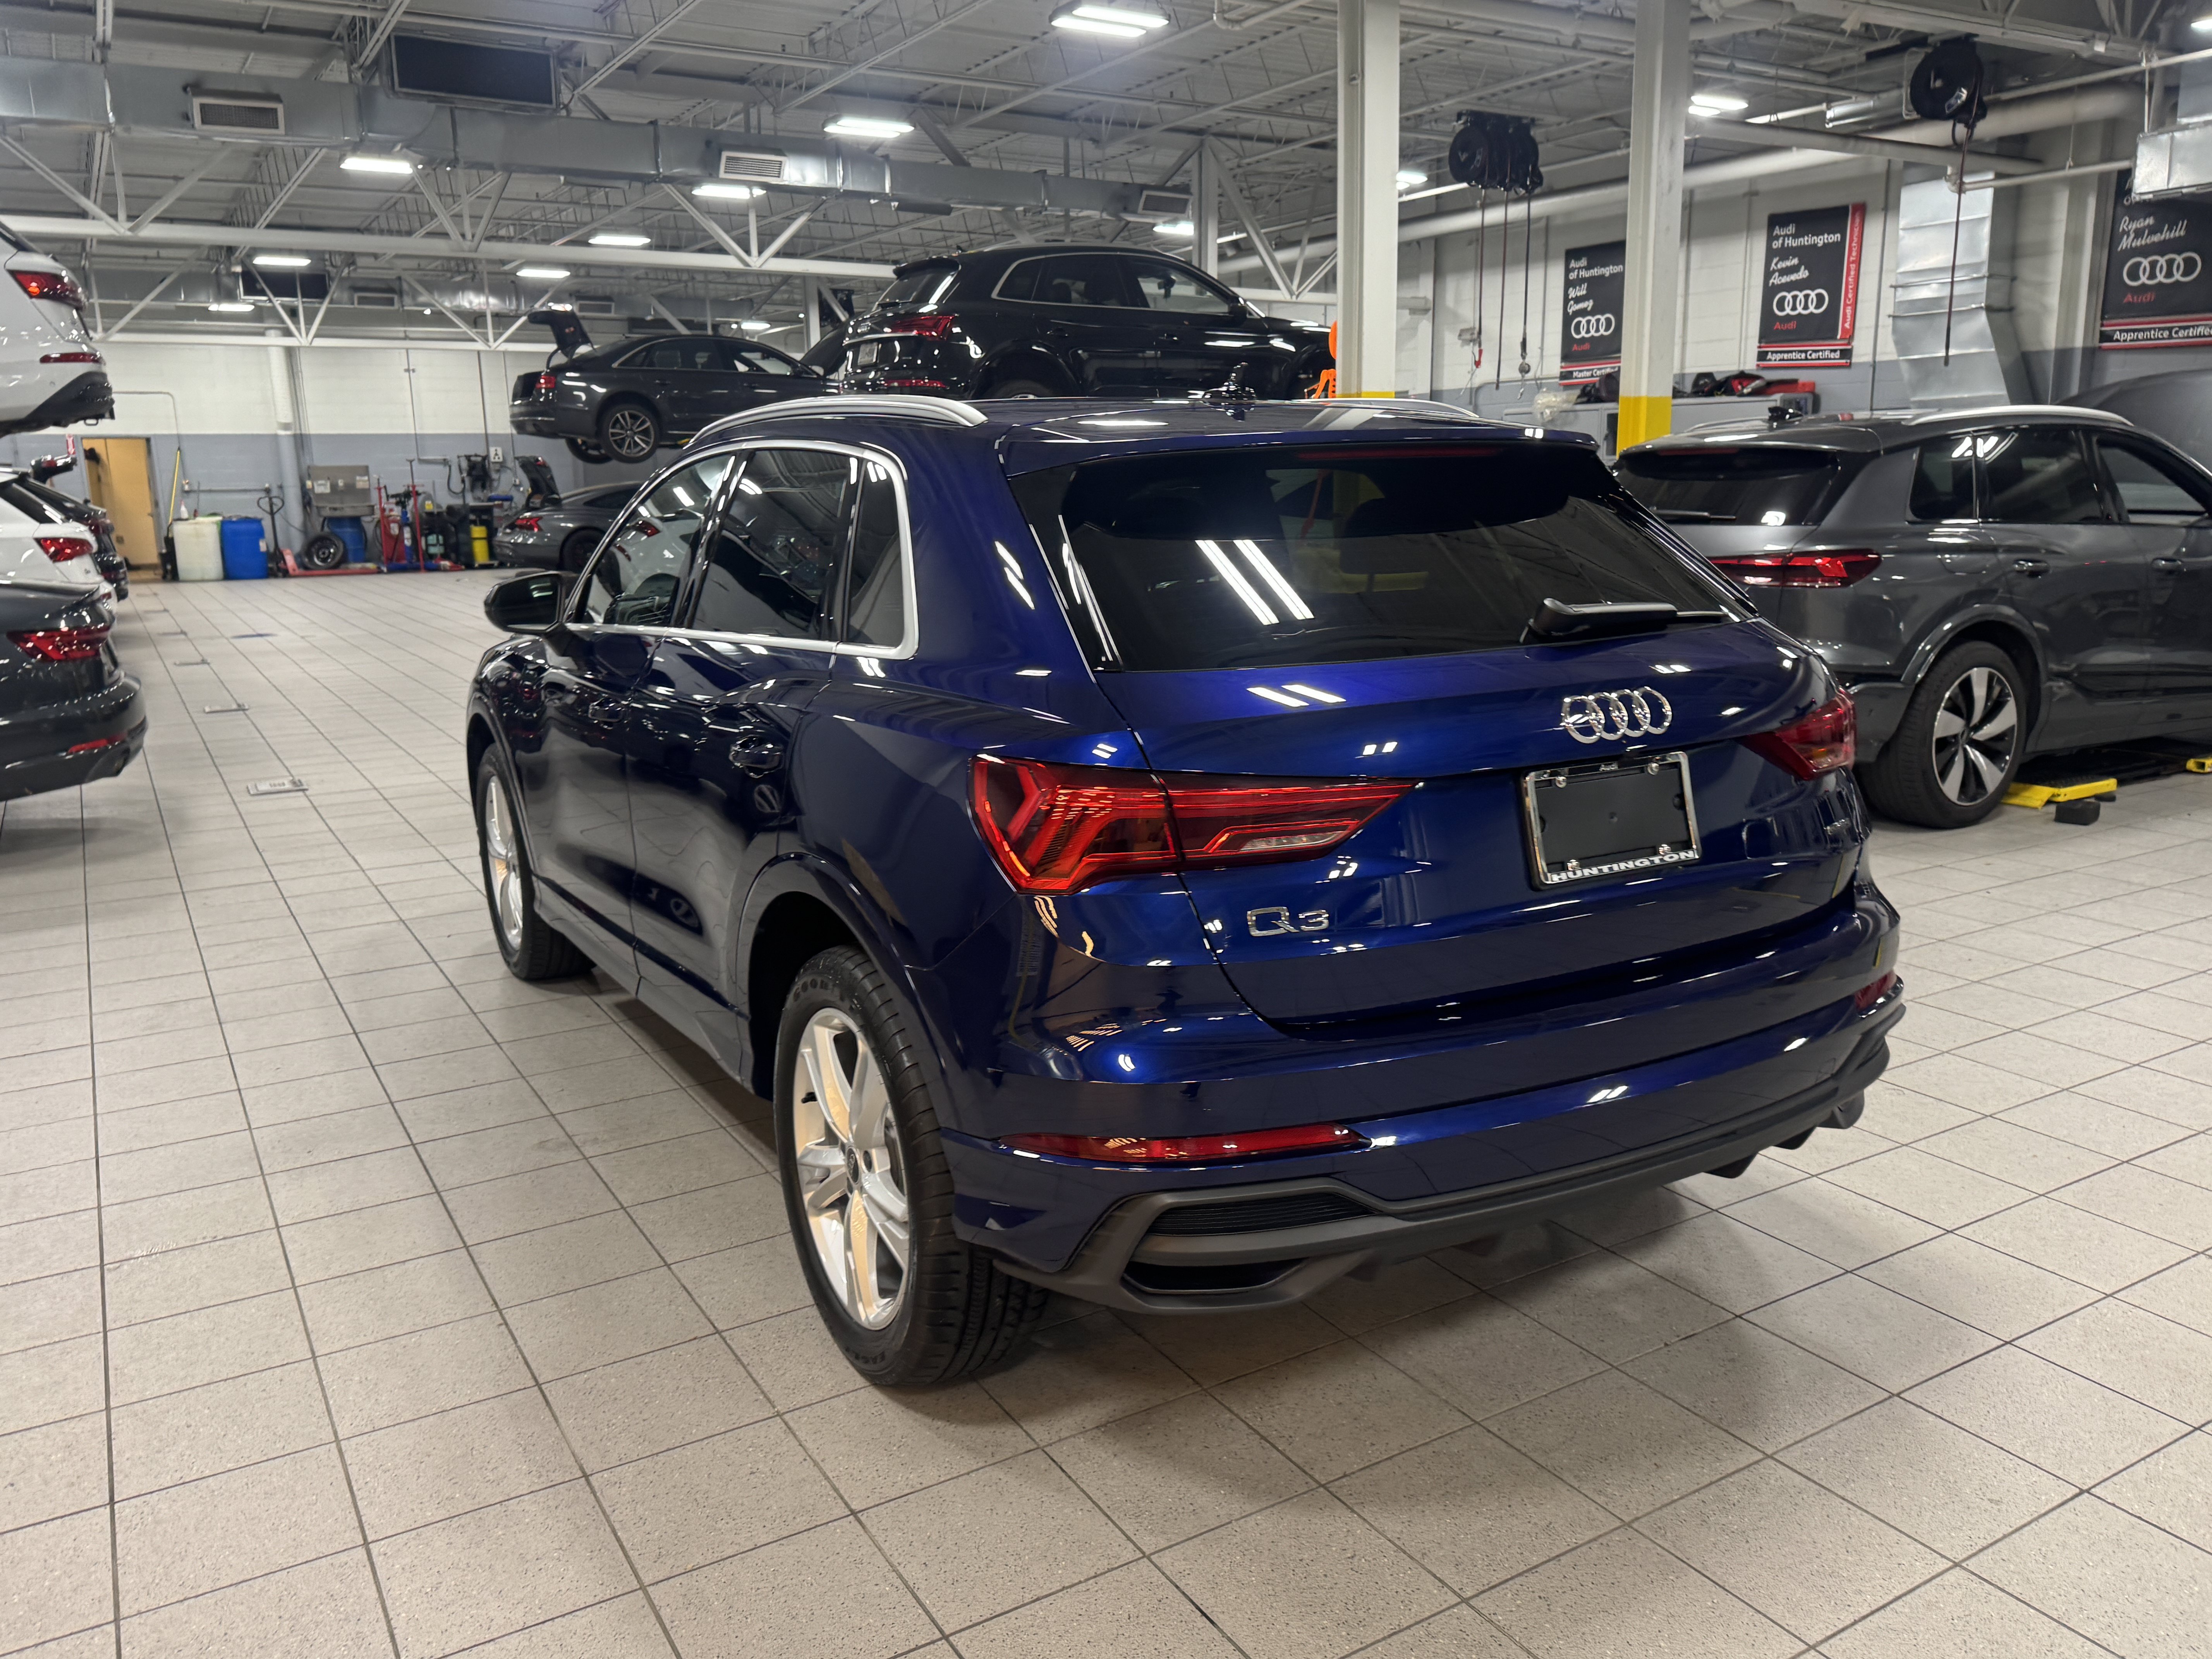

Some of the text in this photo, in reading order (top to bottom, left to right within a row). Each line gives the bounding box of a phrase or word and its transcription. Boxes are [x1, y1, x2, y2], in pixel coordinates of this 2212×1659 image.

[1773, 223, 1796, 237] Audi
[2119, 216, 2155, 235] Ryan
[1772, 233, 1841, 249] of Huntington
[1570, 257, 1587, 268] Audi
[1770, 256, 1799, 271] Kevin
[1569, 264, 1623, 280] of Huntington
[1769, 265, 1810, 287] Acevedo
[1568, 283, 1587, 299] Will
[1846, 263, 1856, 304] Certified
[2123, 292, 2156, 303] Audi
[1774, 321, 1797, 330] Audi
[1844, 306, 1852, 329] Audi
[2113, 329, 2169, 342] Apprentice
[1572, 342, 1591, 351] Audi
[1767, 350, 1840, 361] Apprentice Certified
[1551, 850, 1694, 882] HUNTINGTON
[1247, 906, 1329, 937] Q3
